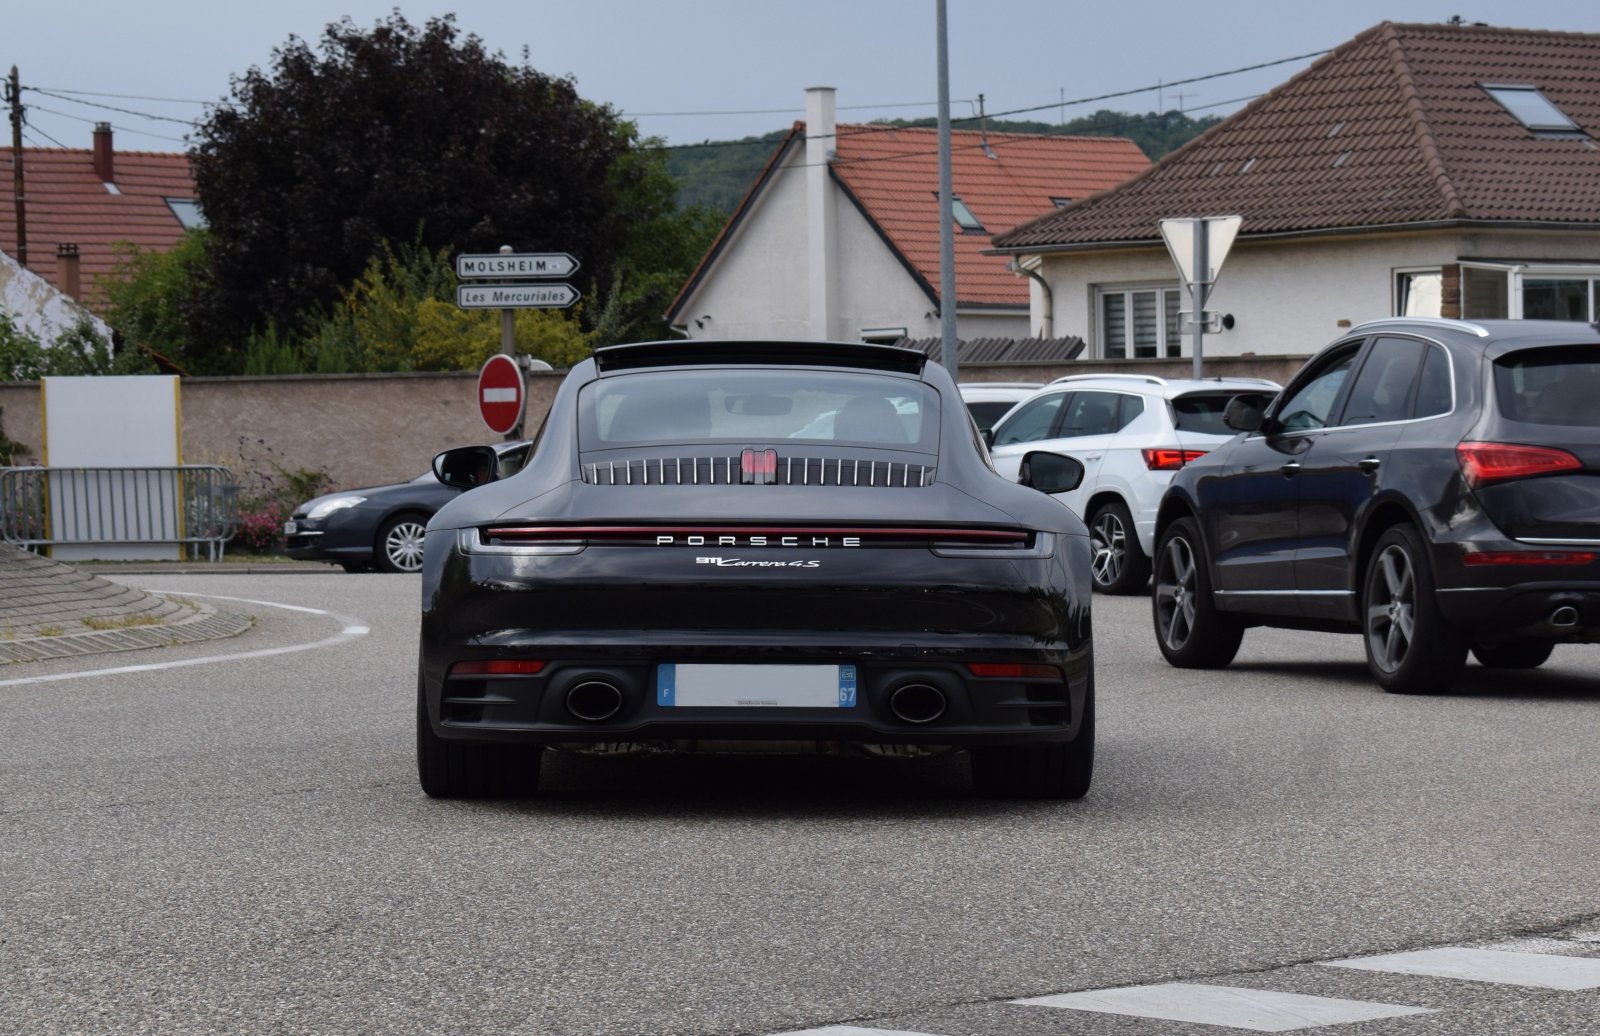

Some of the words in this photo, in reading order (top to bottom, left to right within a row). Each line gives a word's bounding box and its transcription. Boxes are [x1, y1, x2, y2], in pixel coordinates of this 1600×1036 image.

[464, 261, 546, 272] MOLSHEIM
[465, 292, 485, 303] Les
[492, 290, 566, 302] Mercuriales
[656, 535, 861, 547] PORSCHE
[717, 558, 787, 567] Carrera
[663, 688, 670, 698] F
[840, 687, 856, 702] 67
